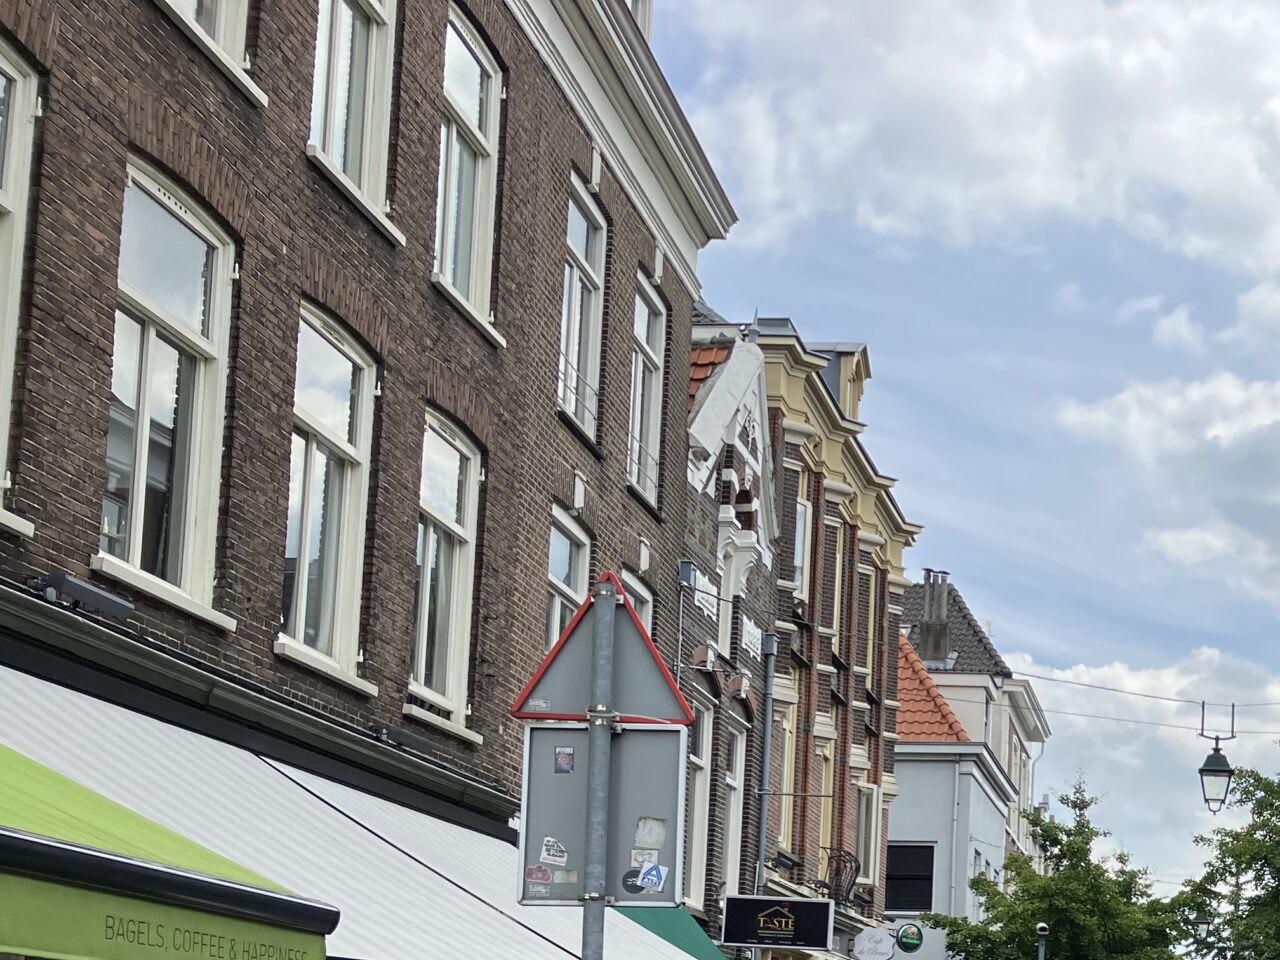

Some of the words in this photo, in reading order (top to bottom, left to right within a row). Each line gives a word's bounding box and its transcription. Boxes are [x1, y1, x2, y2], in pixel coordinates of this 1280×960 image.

[104, 915, 168, 952] BAGELS,
[172, 928, 225, 959] COFFEE
[228, 938, 237, 960] &
